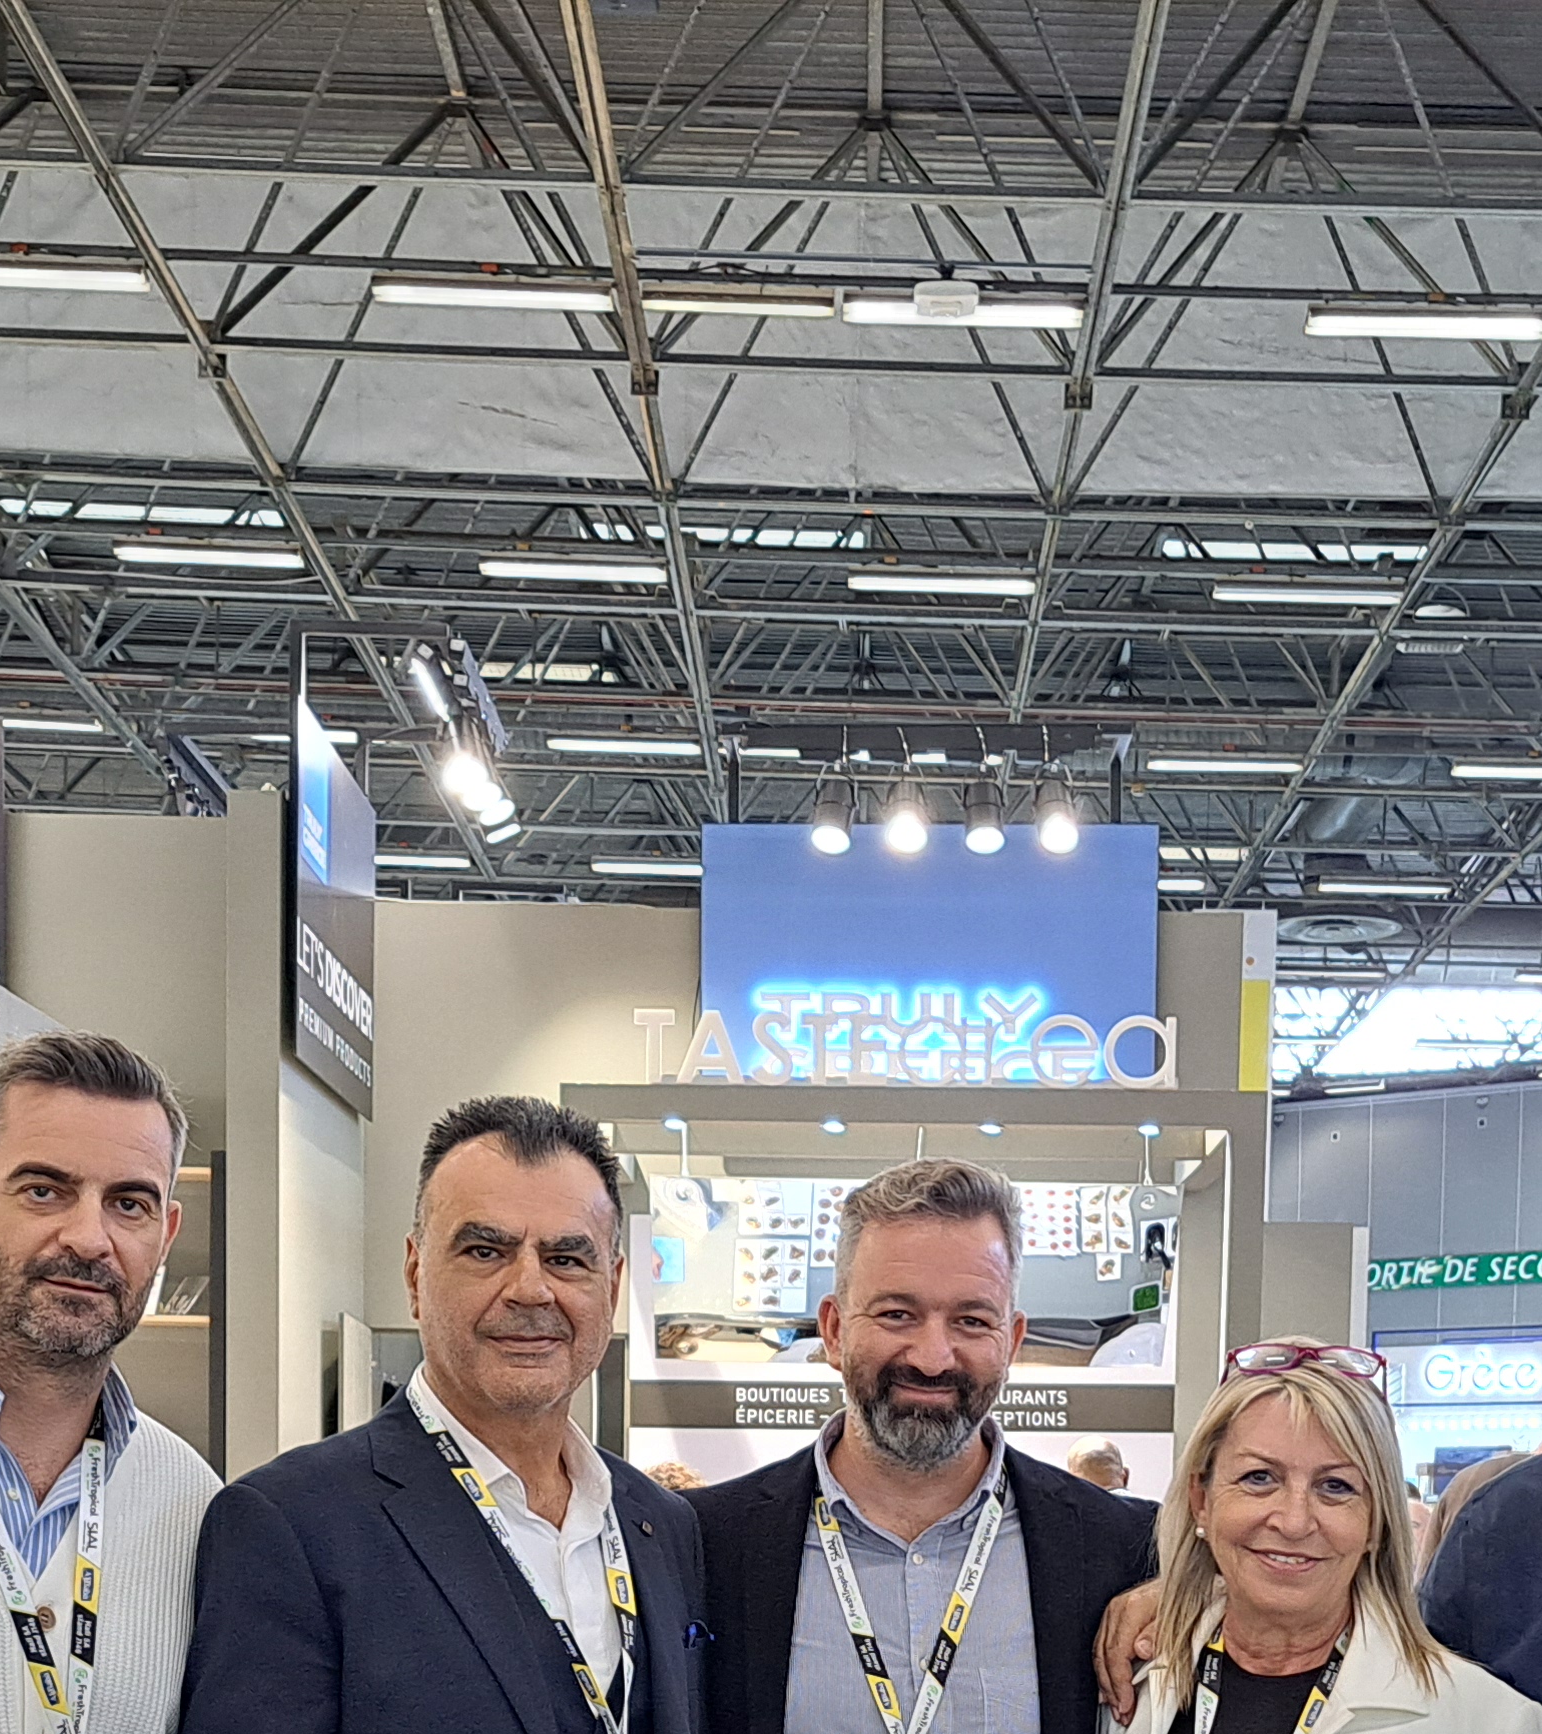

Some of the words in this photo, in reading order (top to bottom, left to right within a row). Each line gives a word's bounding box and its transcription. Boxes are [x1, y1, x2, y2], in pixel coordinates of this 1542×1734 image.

[297, 915, 325, 988] LET'S
[325, 949, 373, 1041] DISCOVER
[298, 997, 333, 1050] PREMIUM
[336, 1034, 371, 1087] PRODUCTS
[1444, 1256, 1479, 1284] DE
[1425, 1348, 1537, 1391] Grèce
[735, 1387, 830, 1403] BOUTIQUES
[735, 1406, 815, 1424] ÉPICERIE
[87, 1457, 100, 1515] FreshTropical
[85, 1522, 97, 1552] SIAL
[972, 1515, 997, 1565] FreshTropical
[833, 1564, 858, 1617] FreshTropical
